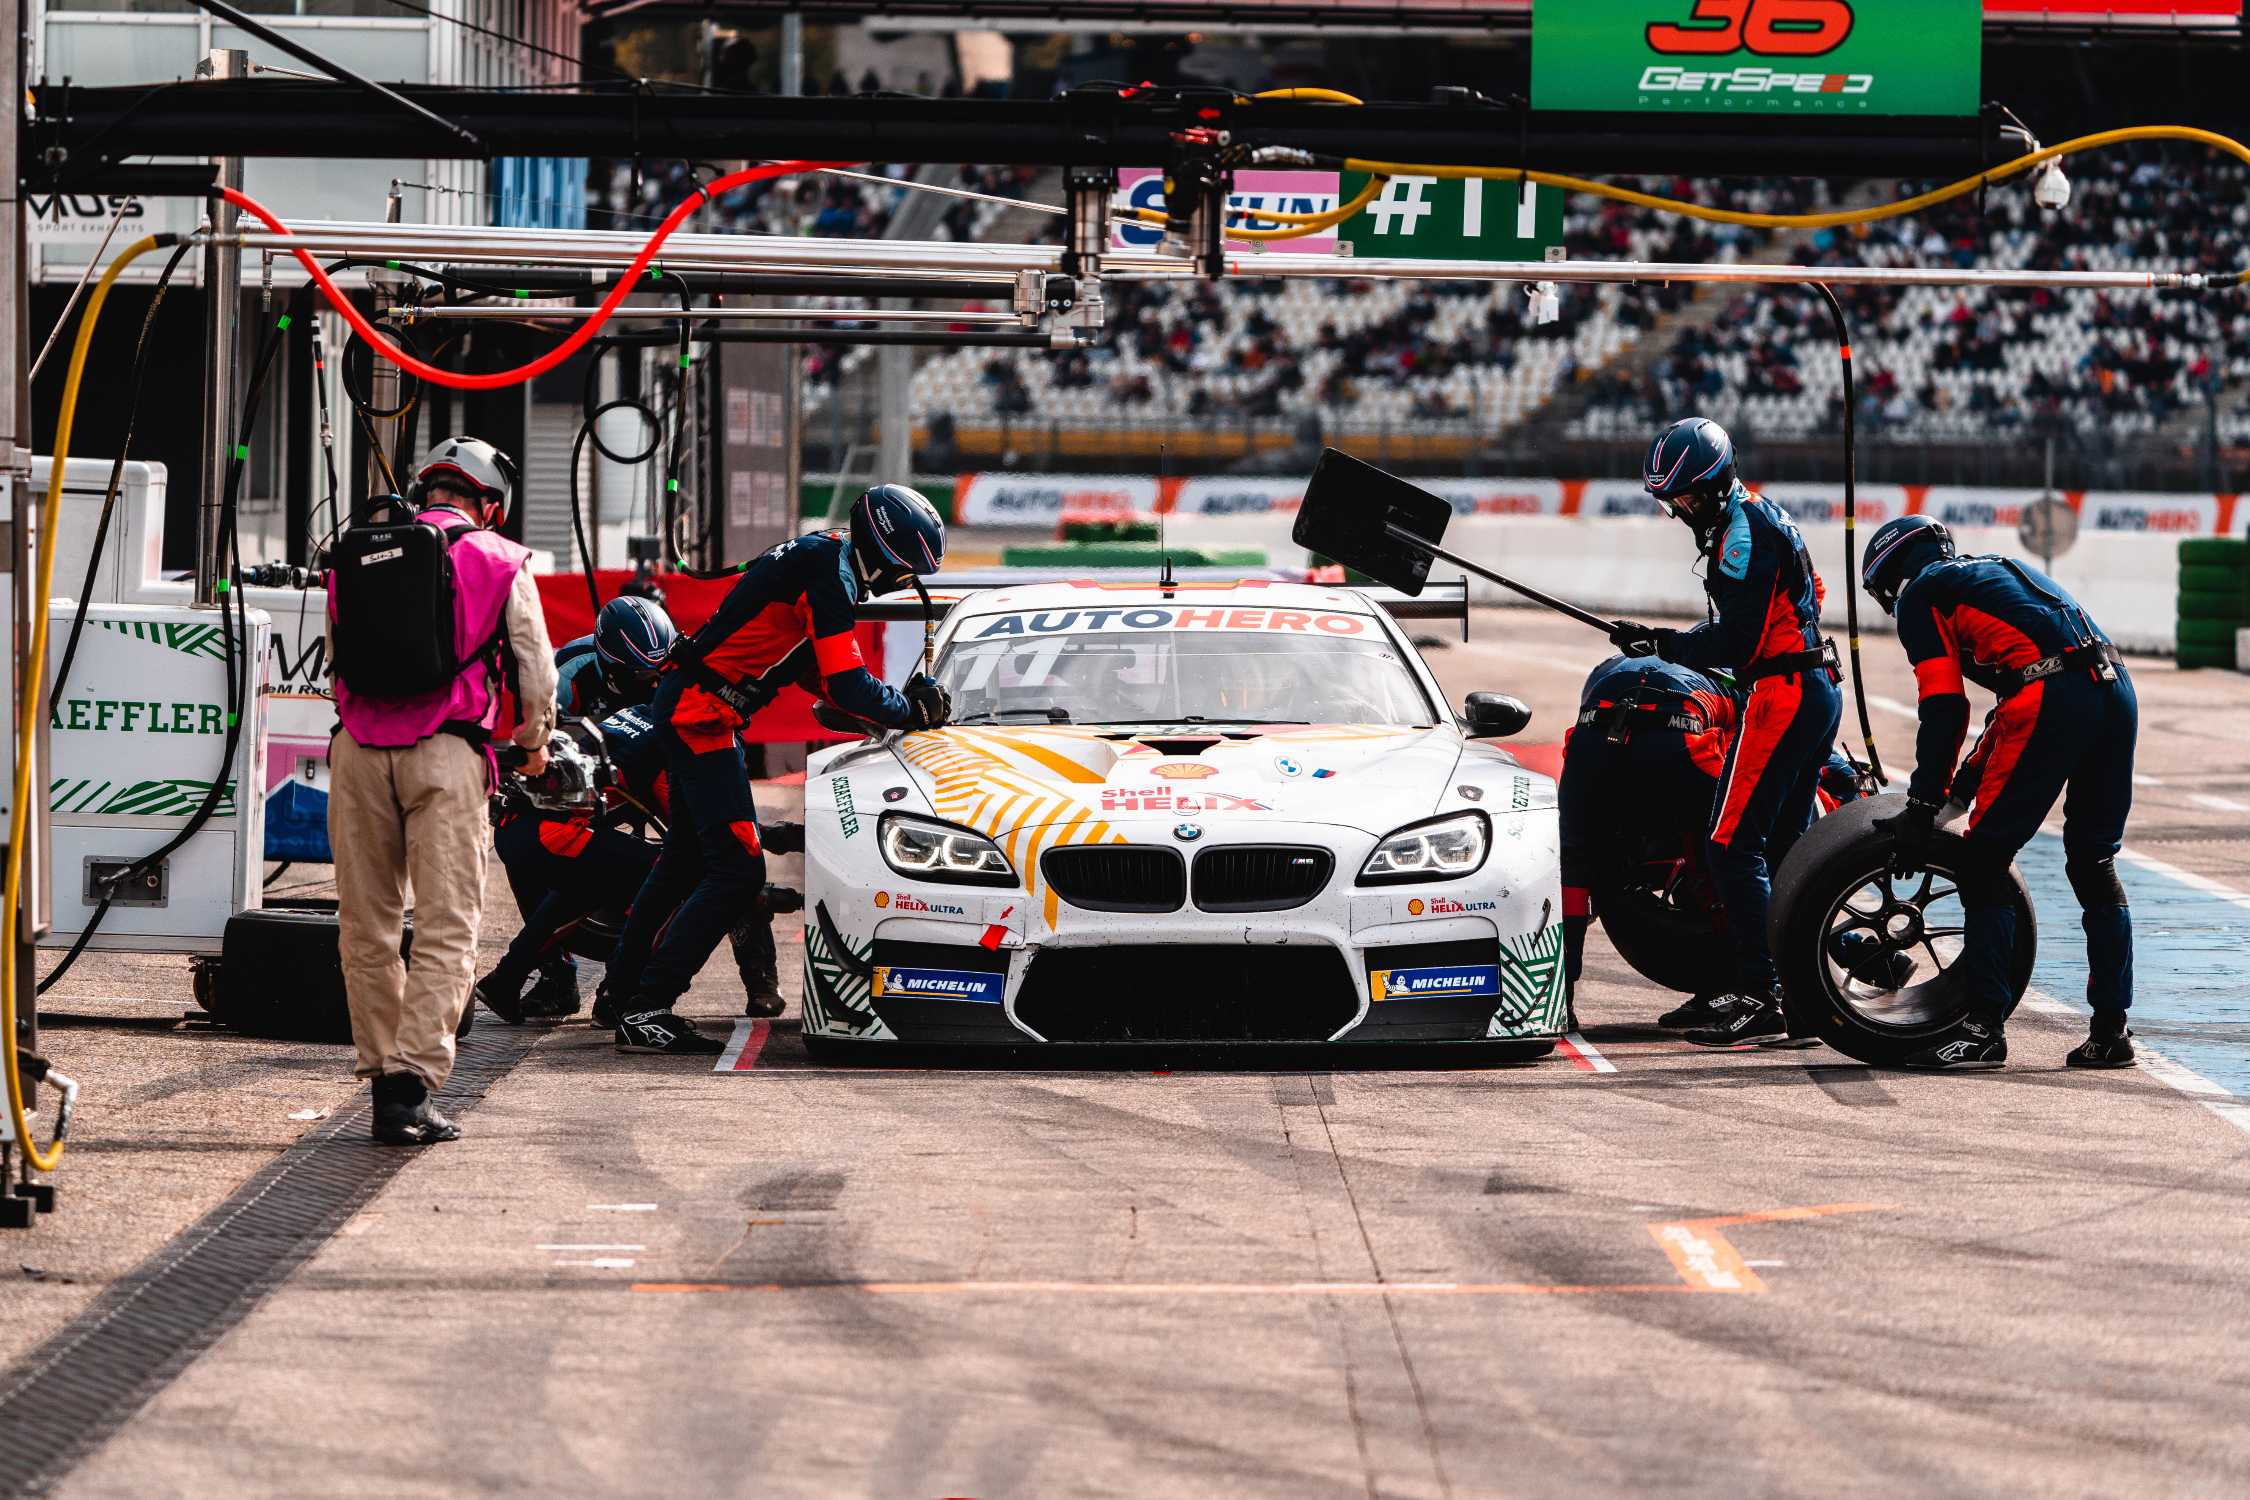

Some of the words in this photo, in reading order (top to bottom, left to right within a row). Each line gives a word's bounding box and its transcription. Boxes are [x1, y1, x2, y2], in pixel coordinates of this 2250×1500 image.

[975, 609, 1365, 638] AUTOHERO
[953, 637, 1068, 692] 11
[1101, 786, 1171, 797] Shell
[1101, 797, 1272, 811] HELIX
[895, 900, 929, 912] HELIX
[930, 904, 965, 915] ULTRA
[1431, 904, 1465, 914] HELIX
[1465, 902, 1497, 912] ULTRA
[906, 978, 987, 993] MICHELIN
[1411, 976, 1486, 989] MICHELIN
